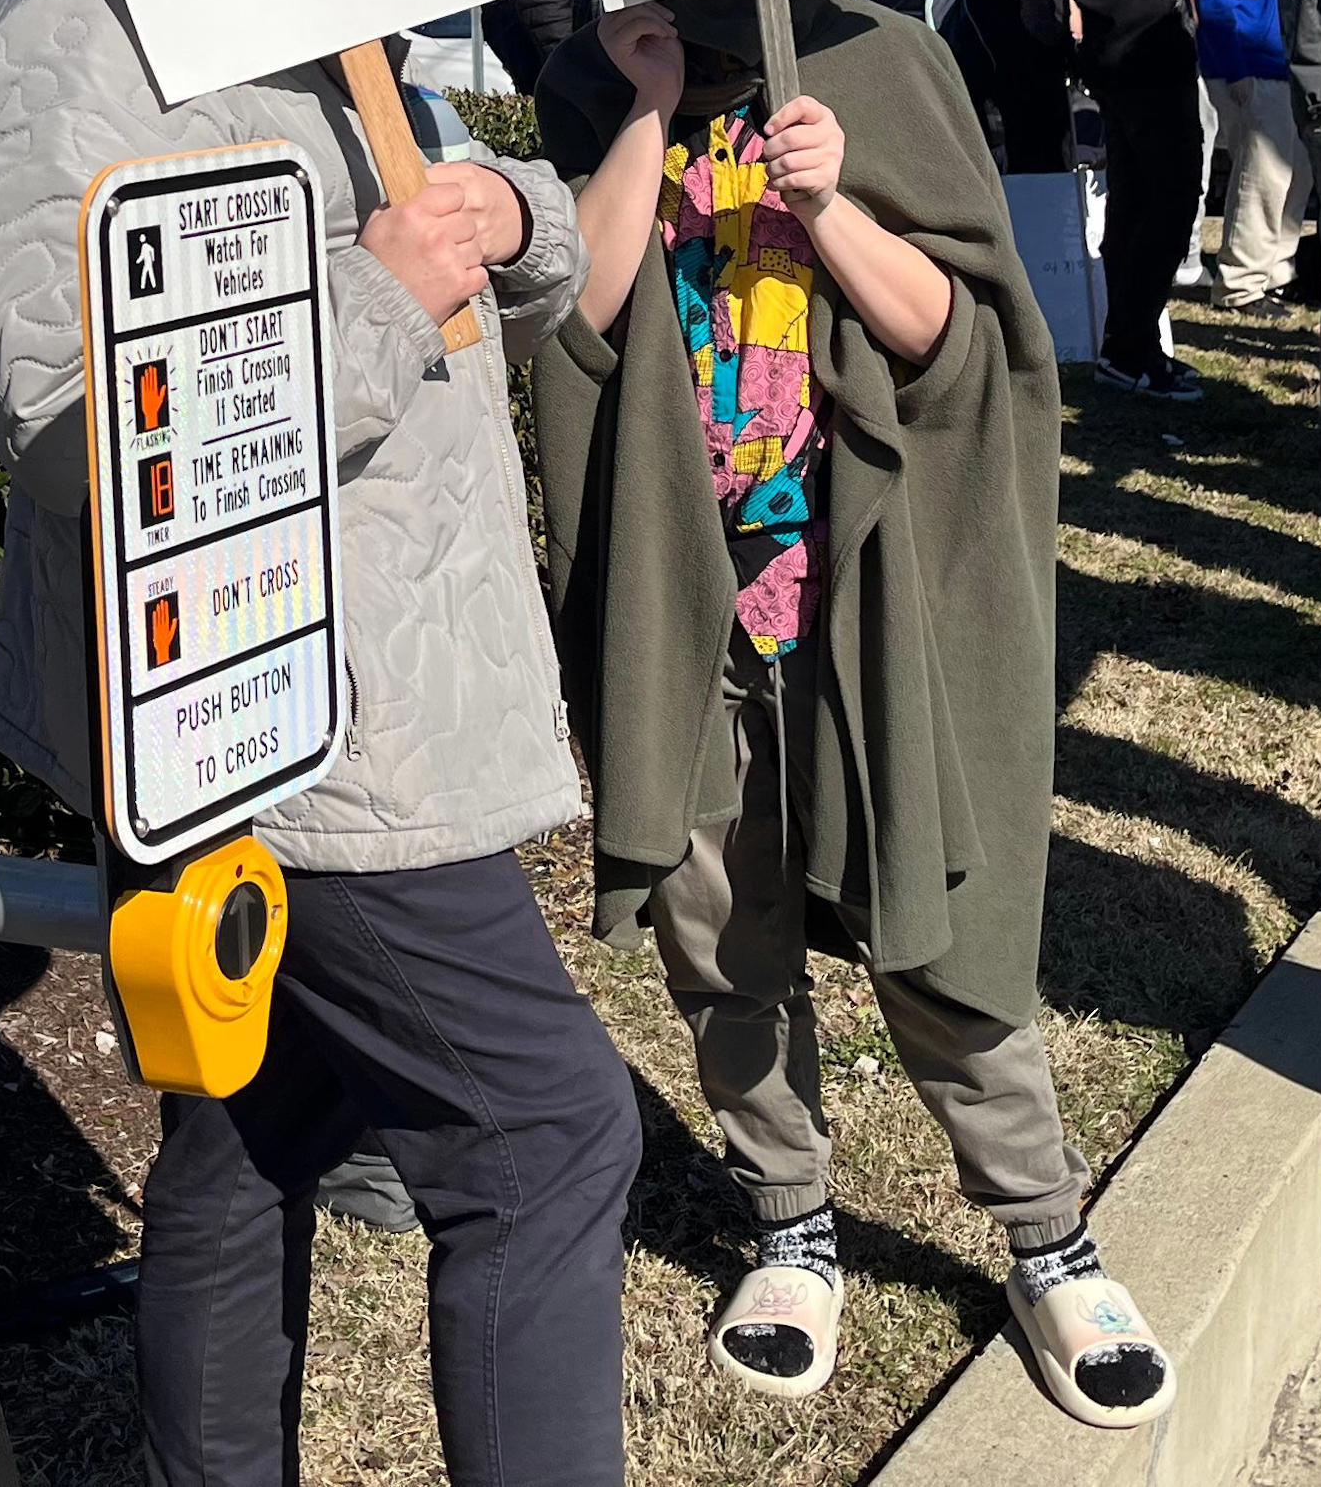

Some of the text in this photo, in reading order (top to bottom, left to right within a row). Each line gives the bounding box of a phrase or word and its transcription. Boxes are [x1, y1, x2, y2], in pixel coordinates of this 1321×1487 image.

[179, 186, 290, 231] START CROSSING
[205, 229, 268, 266] Watch For
[214, 267, 264, 298] Vehicles
[199, 310, 283, 357] DON'T START
[197, 350, 291, 397] Finish Crossing
[216, 386, 276, 426] If Started
[136, 430, 171, 451] FLASHING
[192, 428, 303, 487] TIME REMAINING
[192, 465, 306, 523] To Finish Crossing
[146, 527, 170, 547] TIMER
[148, 576, 175, 598] STEADY
[212, 559, 299, 616] DON'T CROSS
[177, 662, 291, 738] PUSH BUTTON
[196, 726, 279, 788] TO CROSS
